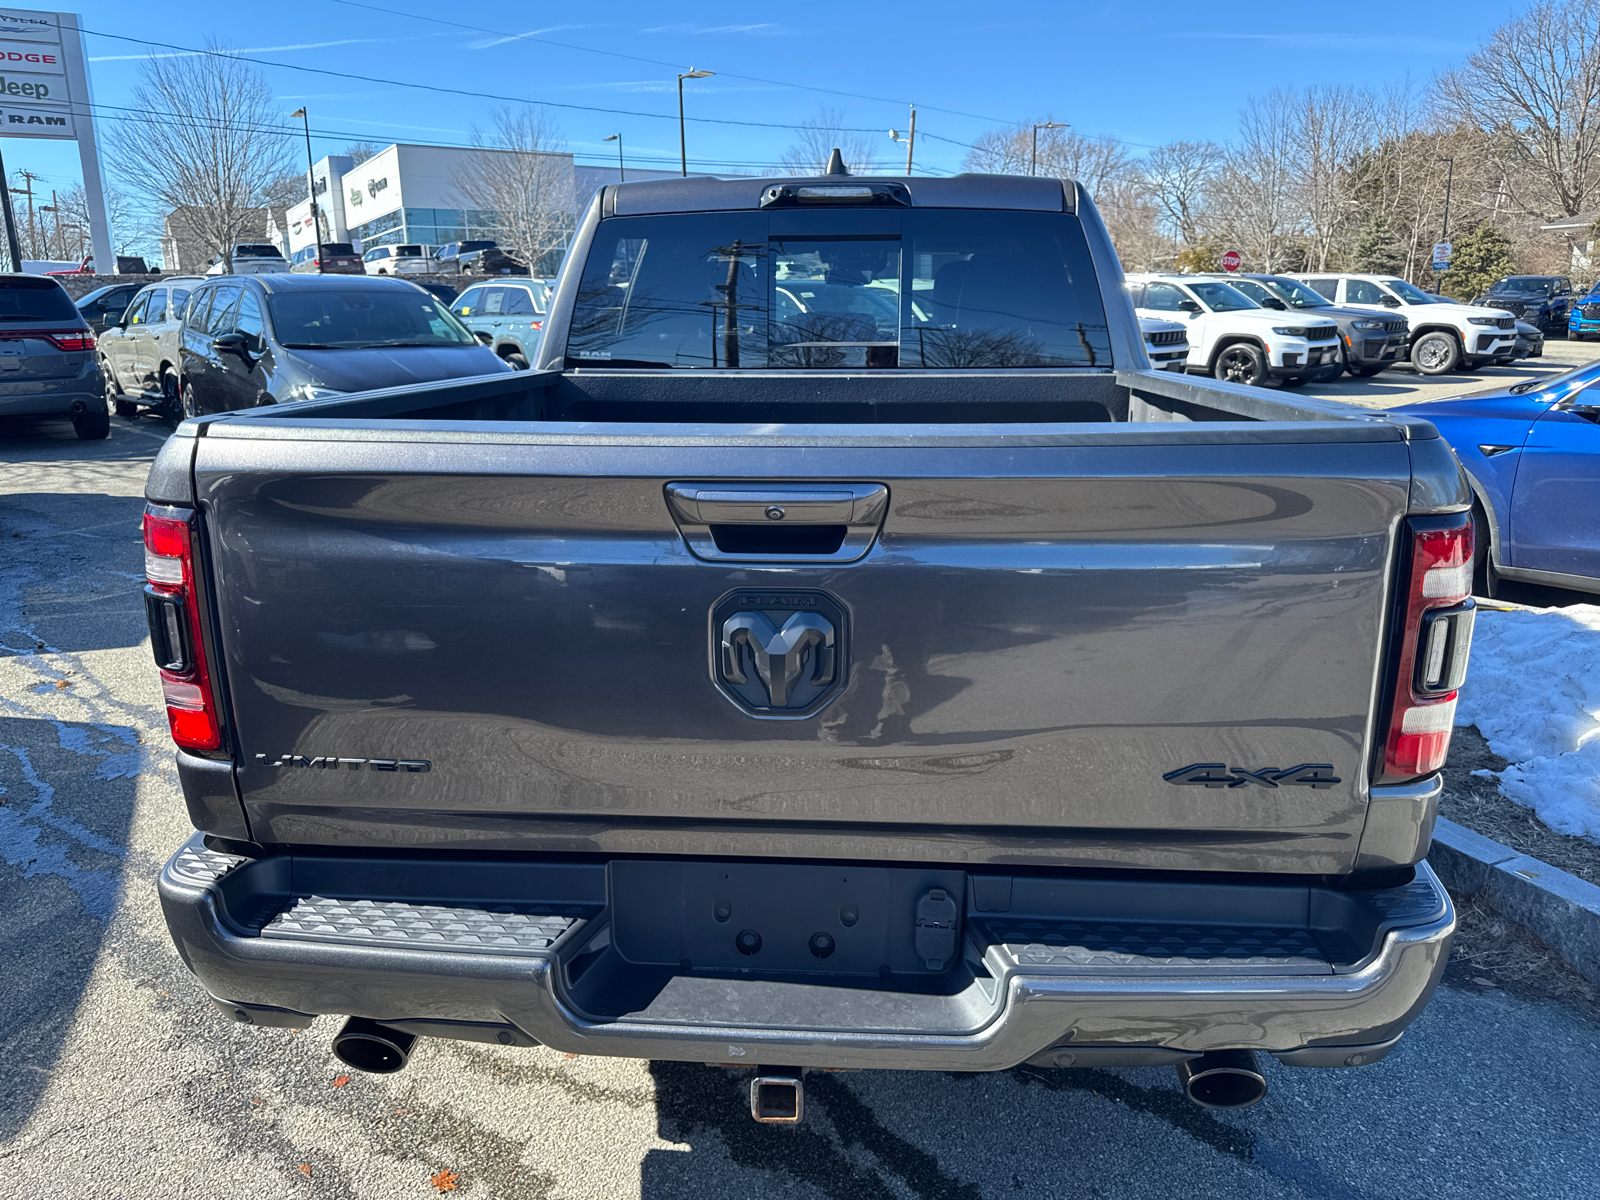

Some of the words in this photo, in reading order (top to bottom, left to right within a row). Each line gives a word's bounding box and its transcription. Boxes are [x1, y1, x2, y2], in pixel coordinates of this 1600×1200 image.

[8, 115, 66, 126] RAM
[1224, 256, 1240, 266] STOP
[739, 596, 818, 607] RAM
[255, 754, 432, 773] LIMITED
